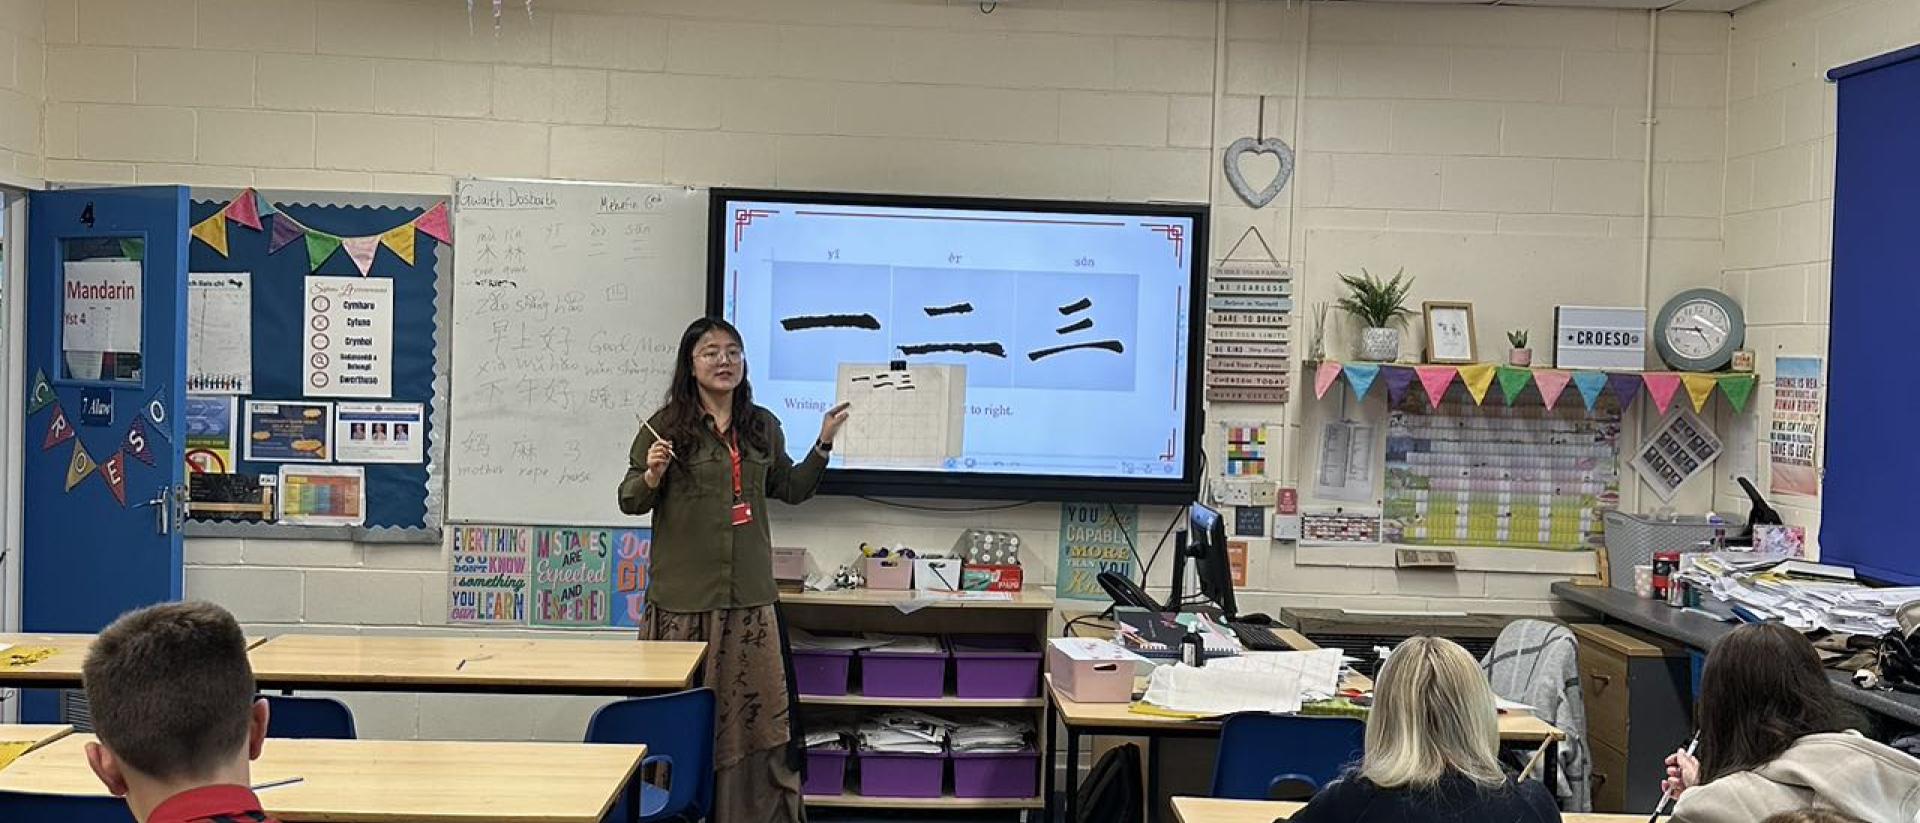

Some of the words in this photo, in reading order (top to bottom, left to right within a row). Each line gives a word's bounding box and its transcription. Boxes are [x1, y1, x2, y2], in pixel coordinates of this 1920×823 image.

[80, 202, 95, 228] 4
[67, 280, 135, 300] Mandarin
[80, 312, 87, 325] 4
[780, 313, 881, 331] 一
[897, 302, 1007, 358] 二
[1028, 297, 1124, 361] 三
[1577, 331, 1630, 346] CROESO
[784, 397, 826, 413] Writing
[971, 405, 982, 415] to
[1771, 441, 1786, 456] LOVE
[1787, 442, 1795, 457] IS
[1796, 443, 1813, 460] LOVE
[1068, 507, 1099, 522] YOU
[454, 527, 526, 552] EVERYTHING
[537, 530, 607, 558] MISTAKES
[454, 556, 487, 564] YOU
[562, 550, 583, 567] ARE
[1071, 546, 1129, 559] MORE
[489, 556, 526, 573] KNOW
[459, 573, 526, 592] something
[536, 560, 608, 590] Expected
[617, 560, 649, 592] GI
[453, 591, 475, 606] YOU
[561, 584, 583, 602] AND
[477, 592, 524, 620] LEARN
